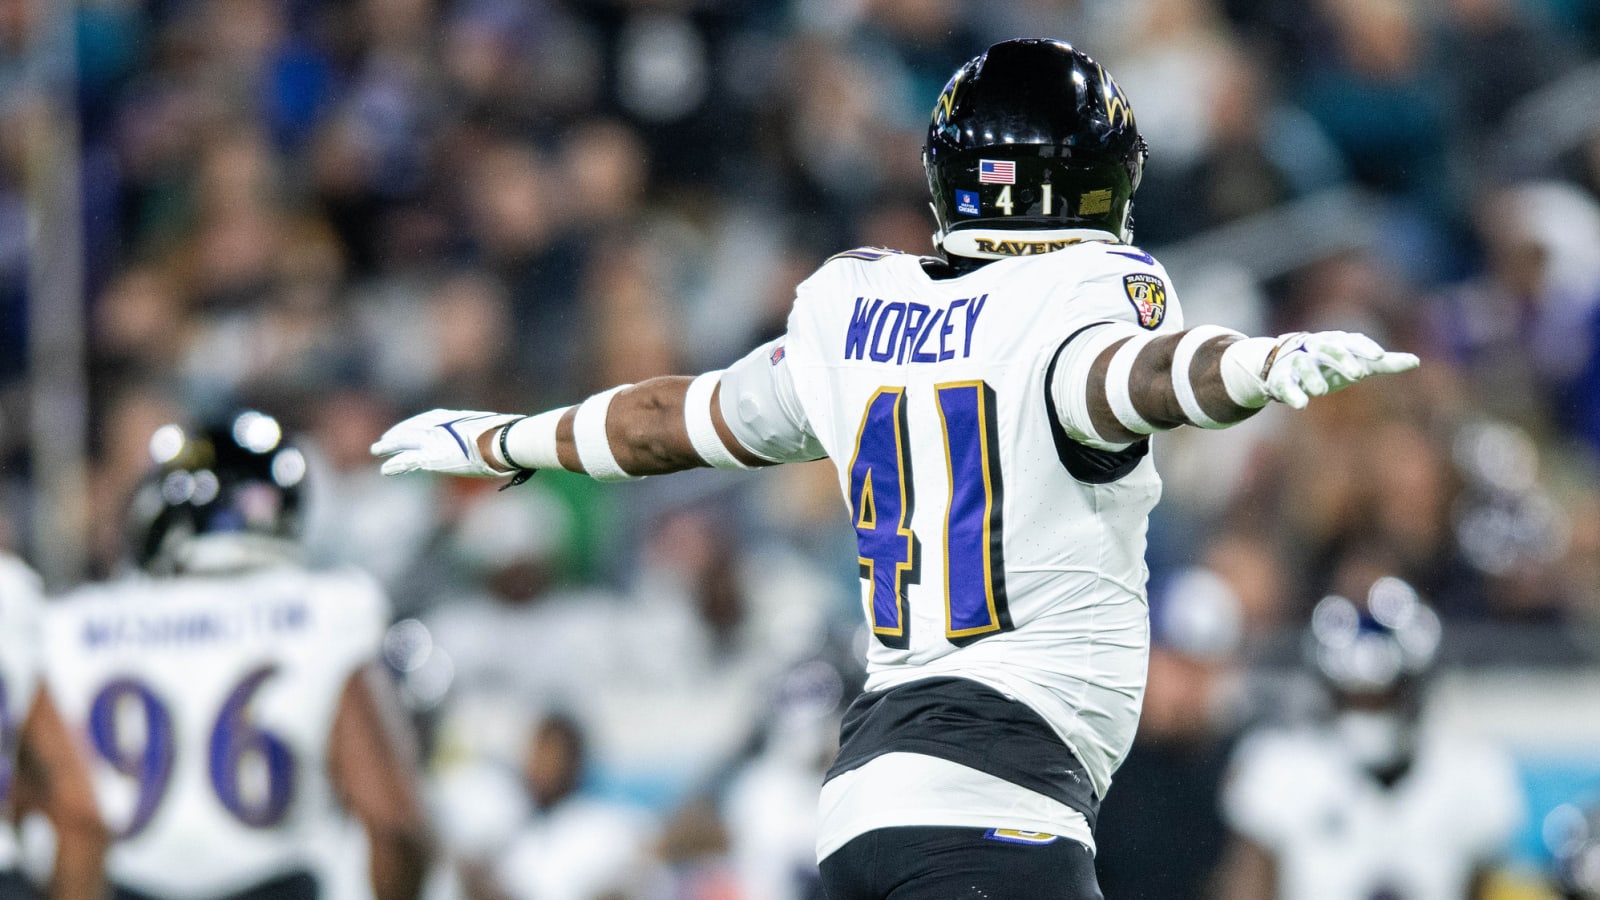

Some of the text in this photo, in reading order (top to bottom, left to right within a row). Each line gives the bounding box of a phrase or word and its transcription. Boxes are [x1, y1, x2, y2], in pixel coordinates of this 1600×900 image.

[974, 237, 1082, 256] RAVEN
[1126, 274, 1162, 287] RAVENS
[844, 293, 989, 365] WORLEY
[849, 379, 1016, 650] 41
[89, 666, 297, 840] 96
